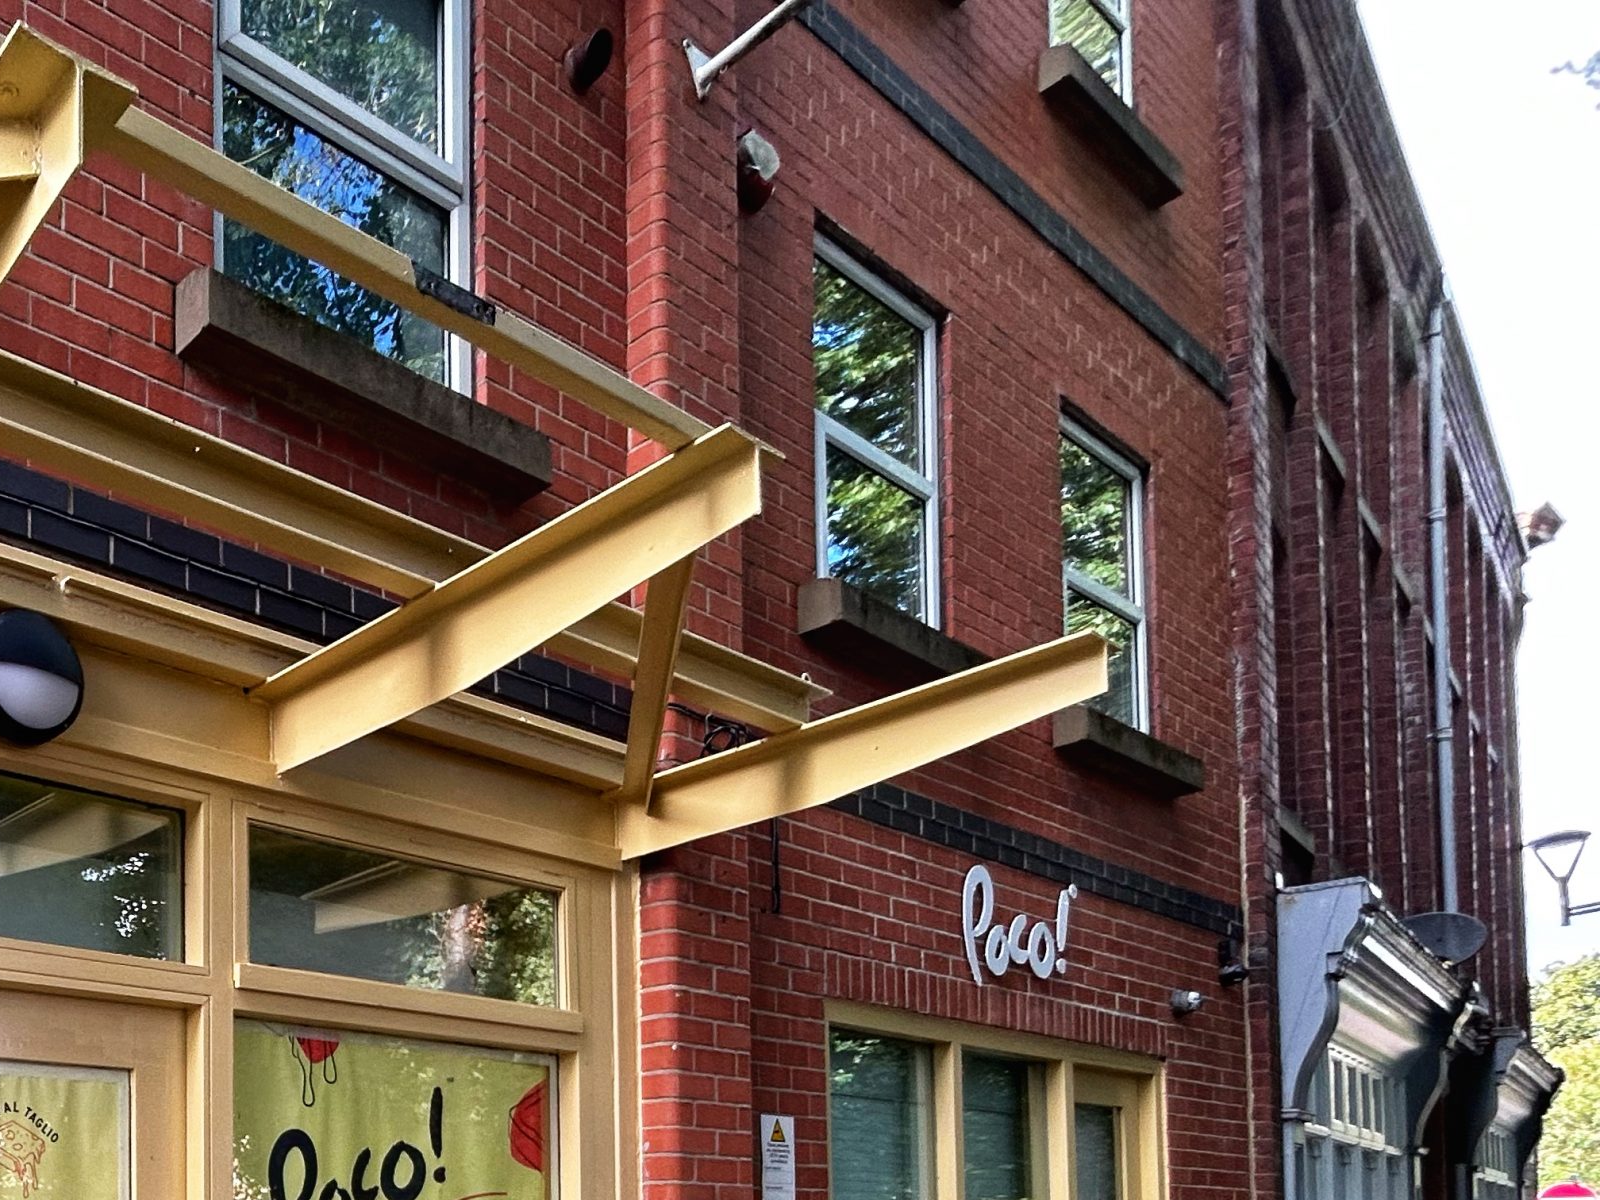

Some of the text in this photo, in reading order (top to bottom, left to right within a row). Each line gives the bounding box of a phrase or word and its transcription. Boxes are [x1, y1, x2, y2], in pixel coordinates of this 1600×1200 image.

[963, 865, 1077, 986] Poco!
[3, 1101, 20, 1113] AL
[24, 1106, 59, 1143] TAGLIO
